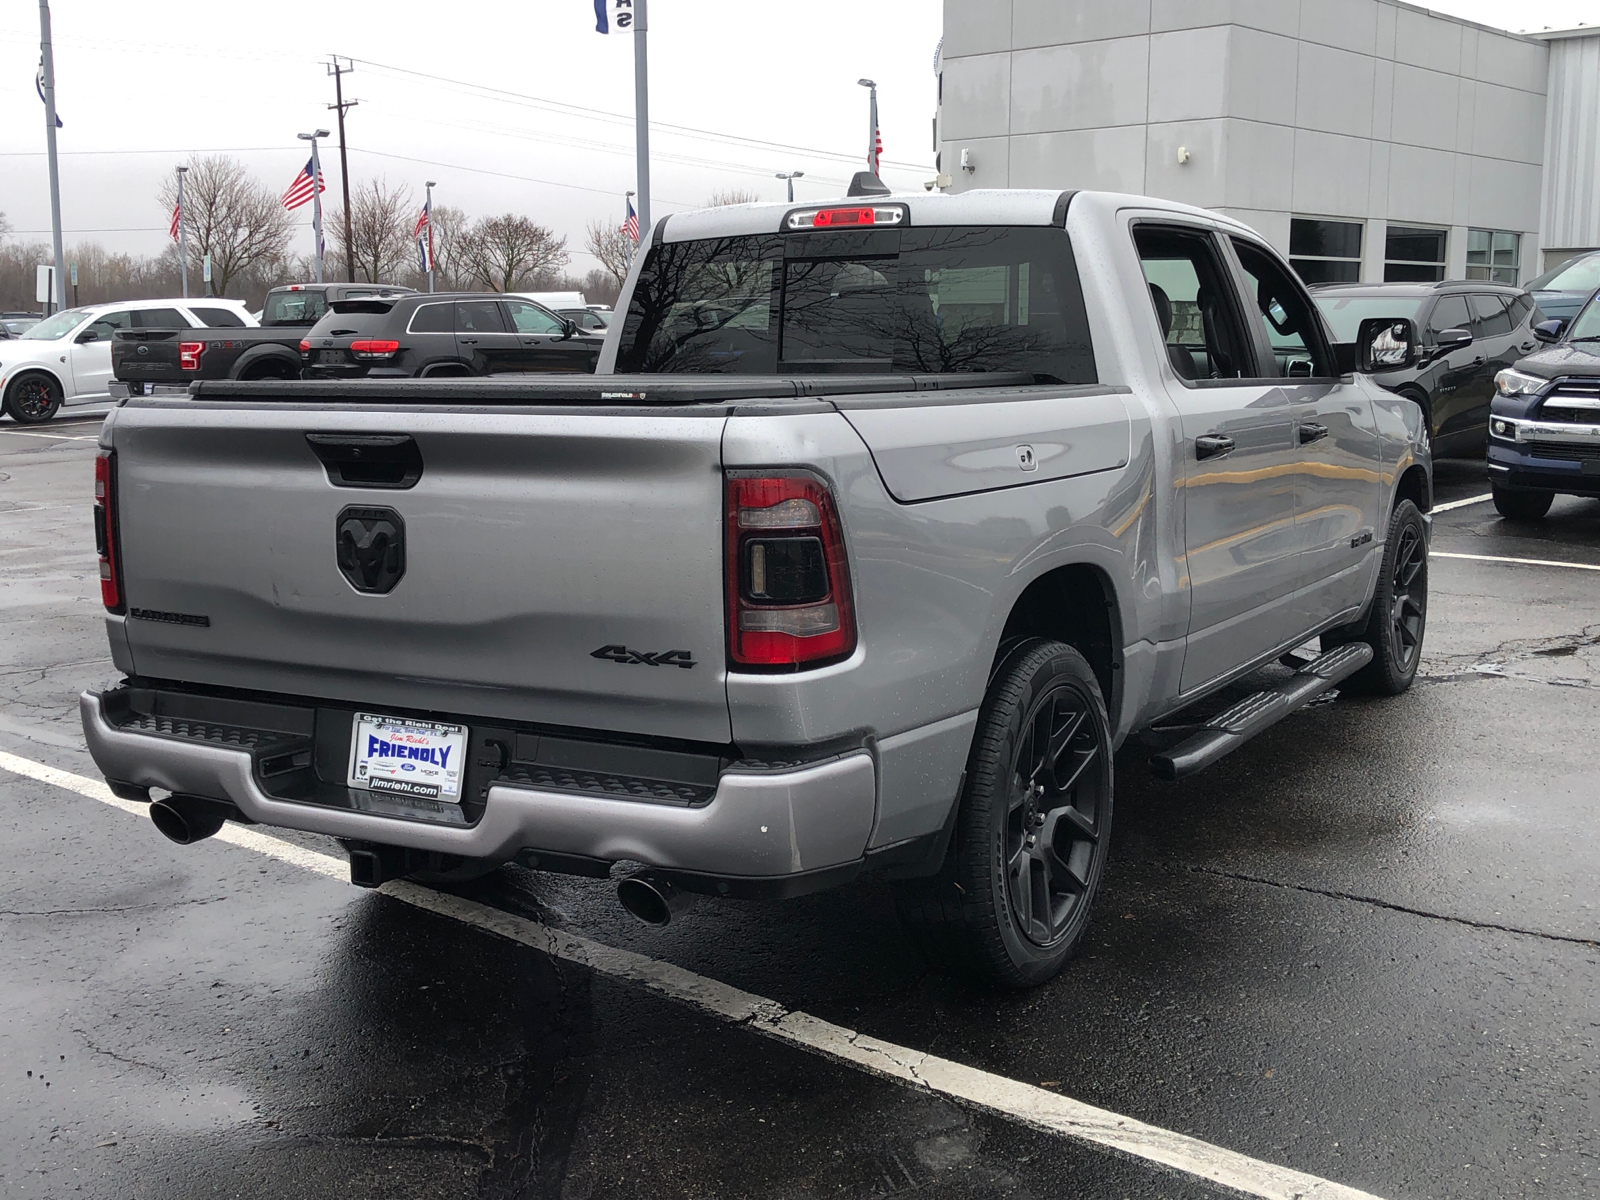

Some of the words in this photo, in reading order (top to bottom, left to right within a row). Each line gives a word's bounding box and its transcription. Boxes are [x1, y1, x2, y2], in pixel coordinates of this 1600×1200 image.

[364, 715, 382, 723] Get
[405, 720, 432, 729] Riehl
[434, 724, 459, 732] Deal
[389, 733, 404, 743] Jim
[405, 734, 430, 746] Riehl's
[368, 734, 452, 769] FRIENDLY
[370, 778, 437, 796] jimriehl.com
